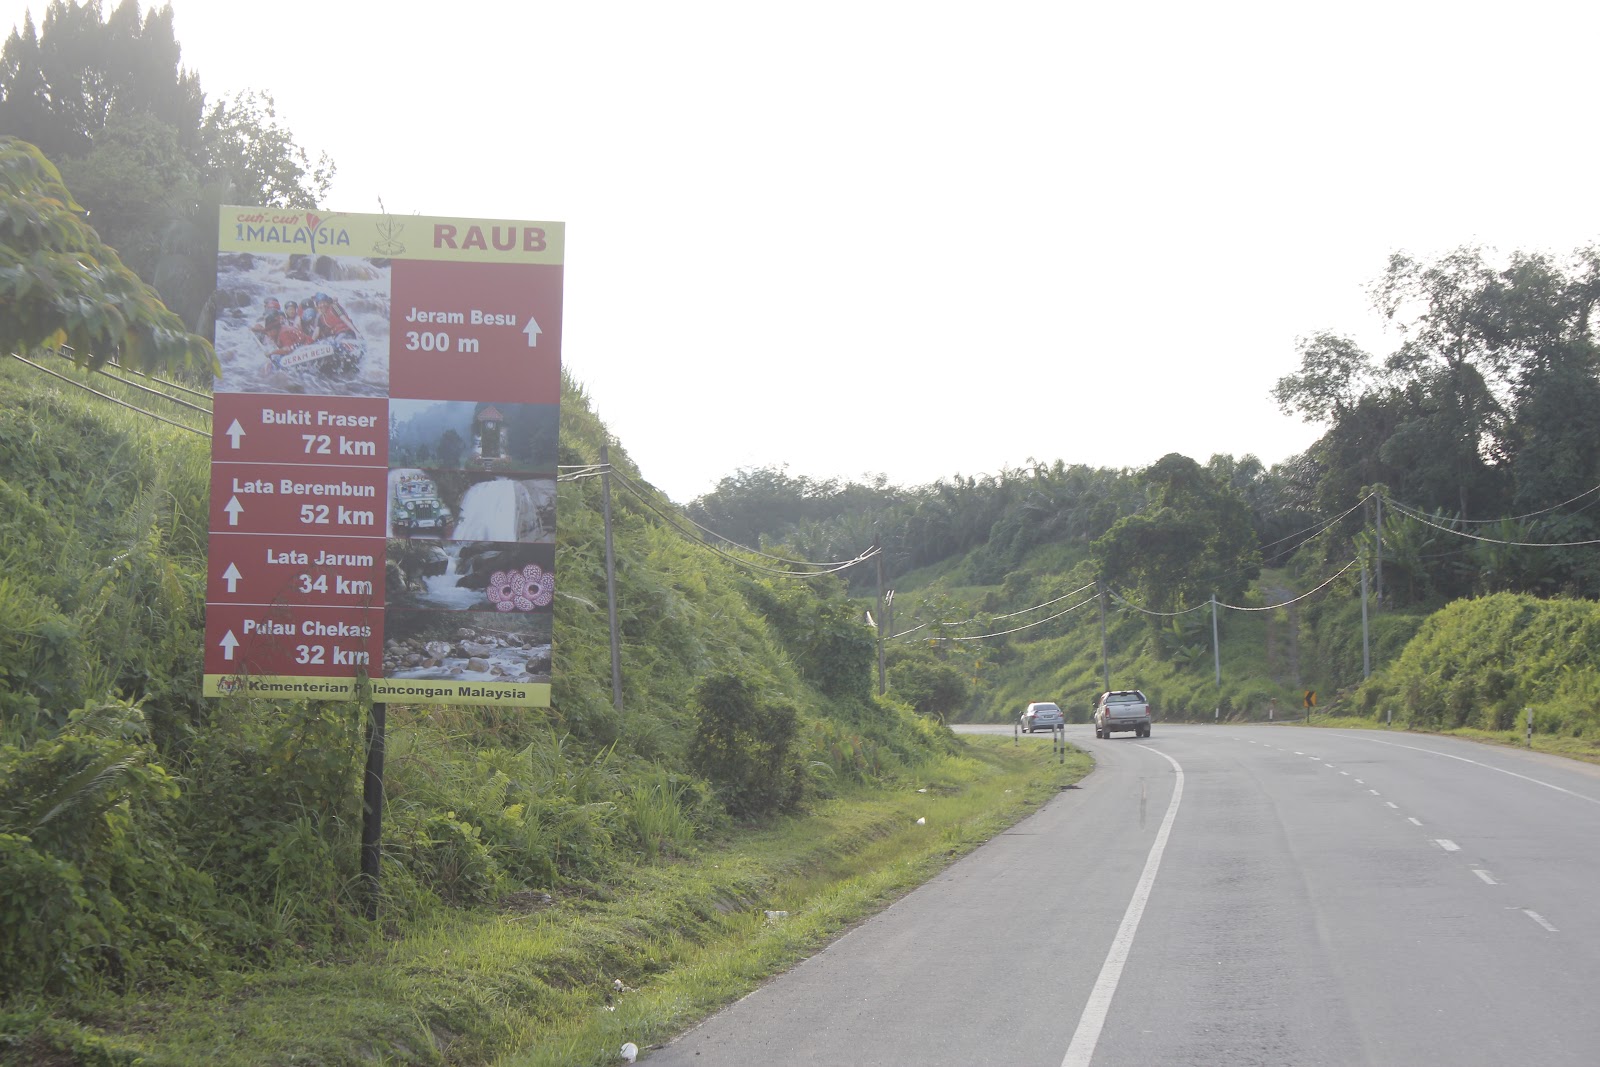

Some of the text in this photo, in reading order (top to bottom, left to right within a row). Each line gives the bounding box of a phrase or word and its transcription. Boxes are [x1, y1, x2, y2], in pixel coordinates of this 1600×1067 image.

[433, 224, 547, 252] RAUB
[405, 307, 516, 326] Jeram Besu
[405, 331, 479, 353] 300 m
[262, 408, 378, 428] Bukit Fraser
[302, 434, 376, 456] 72 km
[232, 478, 375, 498] Lata Berembun
[300, 504, 374, 526] 52 km
[267, 548, 374, 567] Lata Jarum
[299, 574, 373, 595] 34 km
[243, 619, 372, 638] Pulau Chekas
[295, 644, 370, 666] 32 km
[248, 680, 526, 700] Kementerian Plancongan Malaysia
